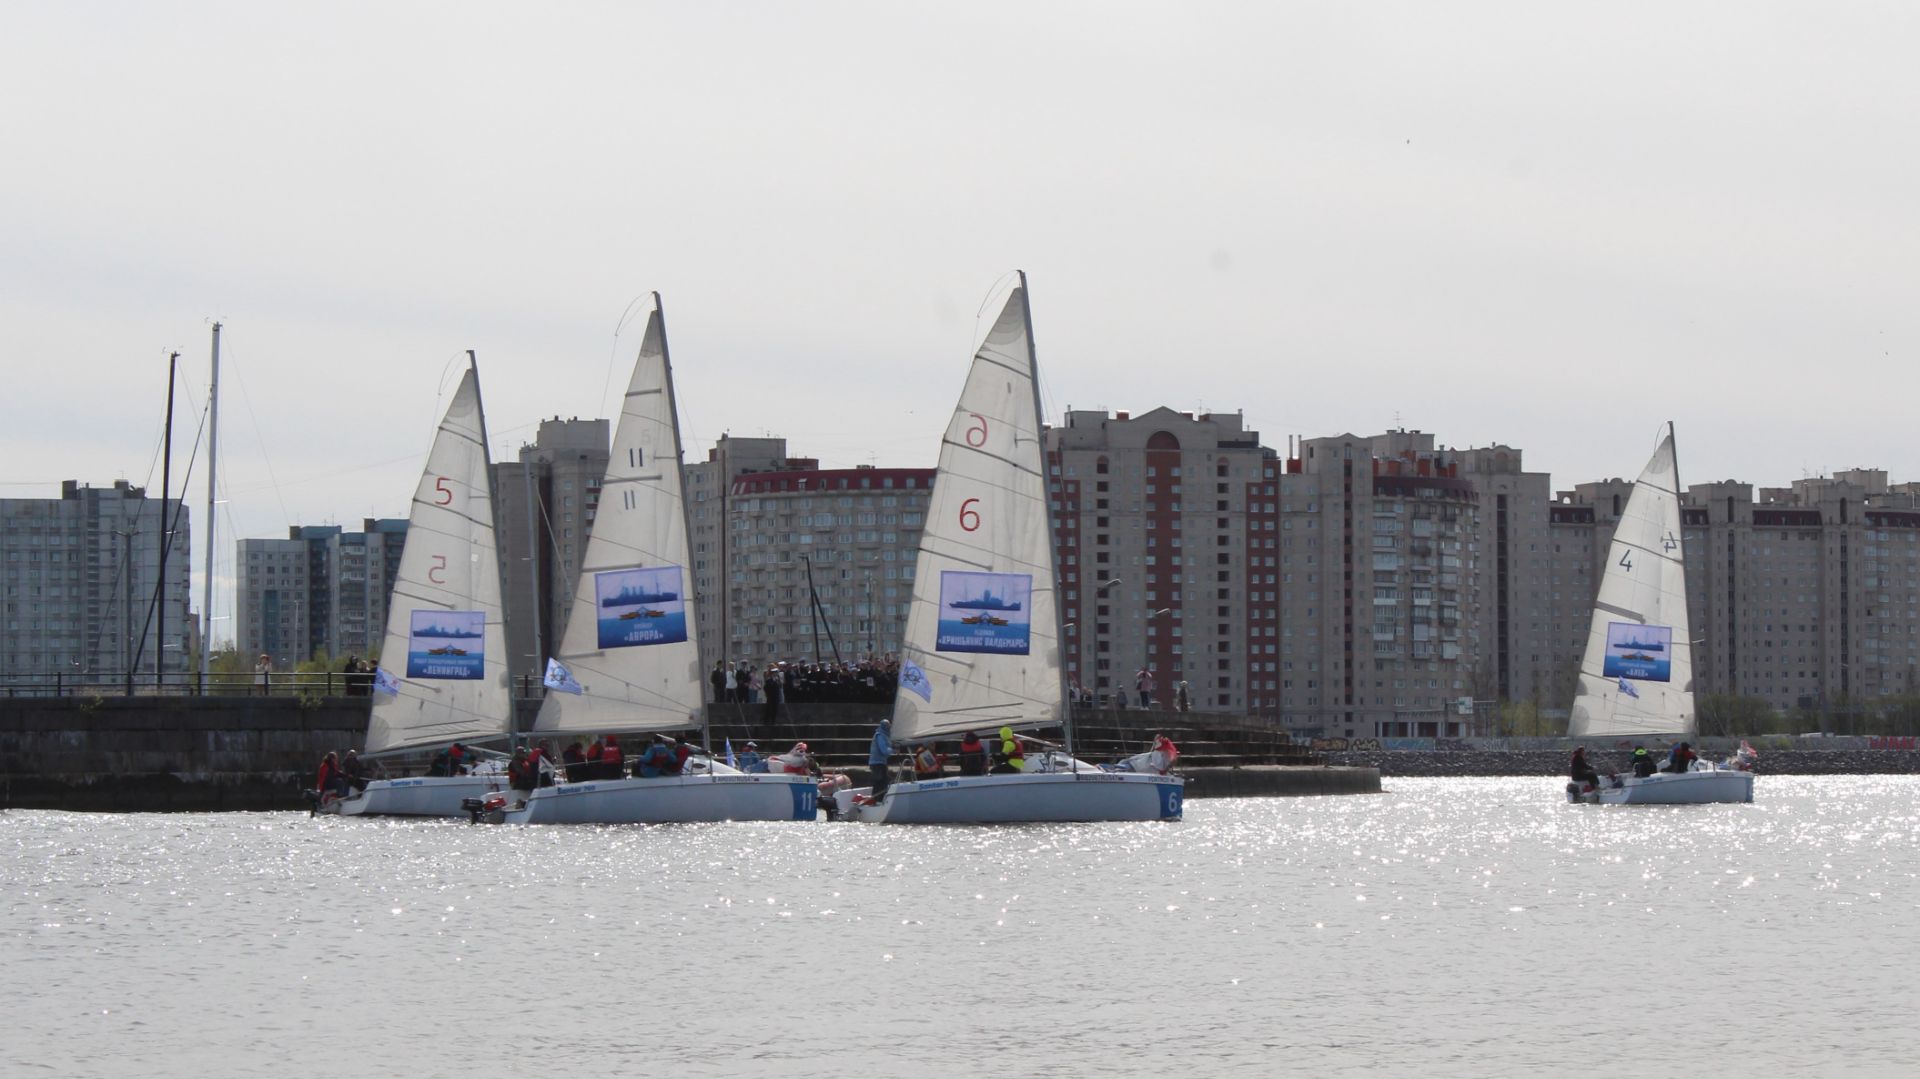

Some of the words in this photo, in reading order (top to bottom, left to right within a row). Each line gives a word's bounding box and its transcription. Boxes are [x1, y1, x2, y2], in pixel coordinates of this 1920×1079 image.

[630, 447, 643, 468] 11
[435, 477, 452, 505] 5
[960, 498, 980, 532] 6
[1619, 549, 1632, 572] 4
[802, 791, 812, 811] 11
[1168, 791, 1178, 812] 6
